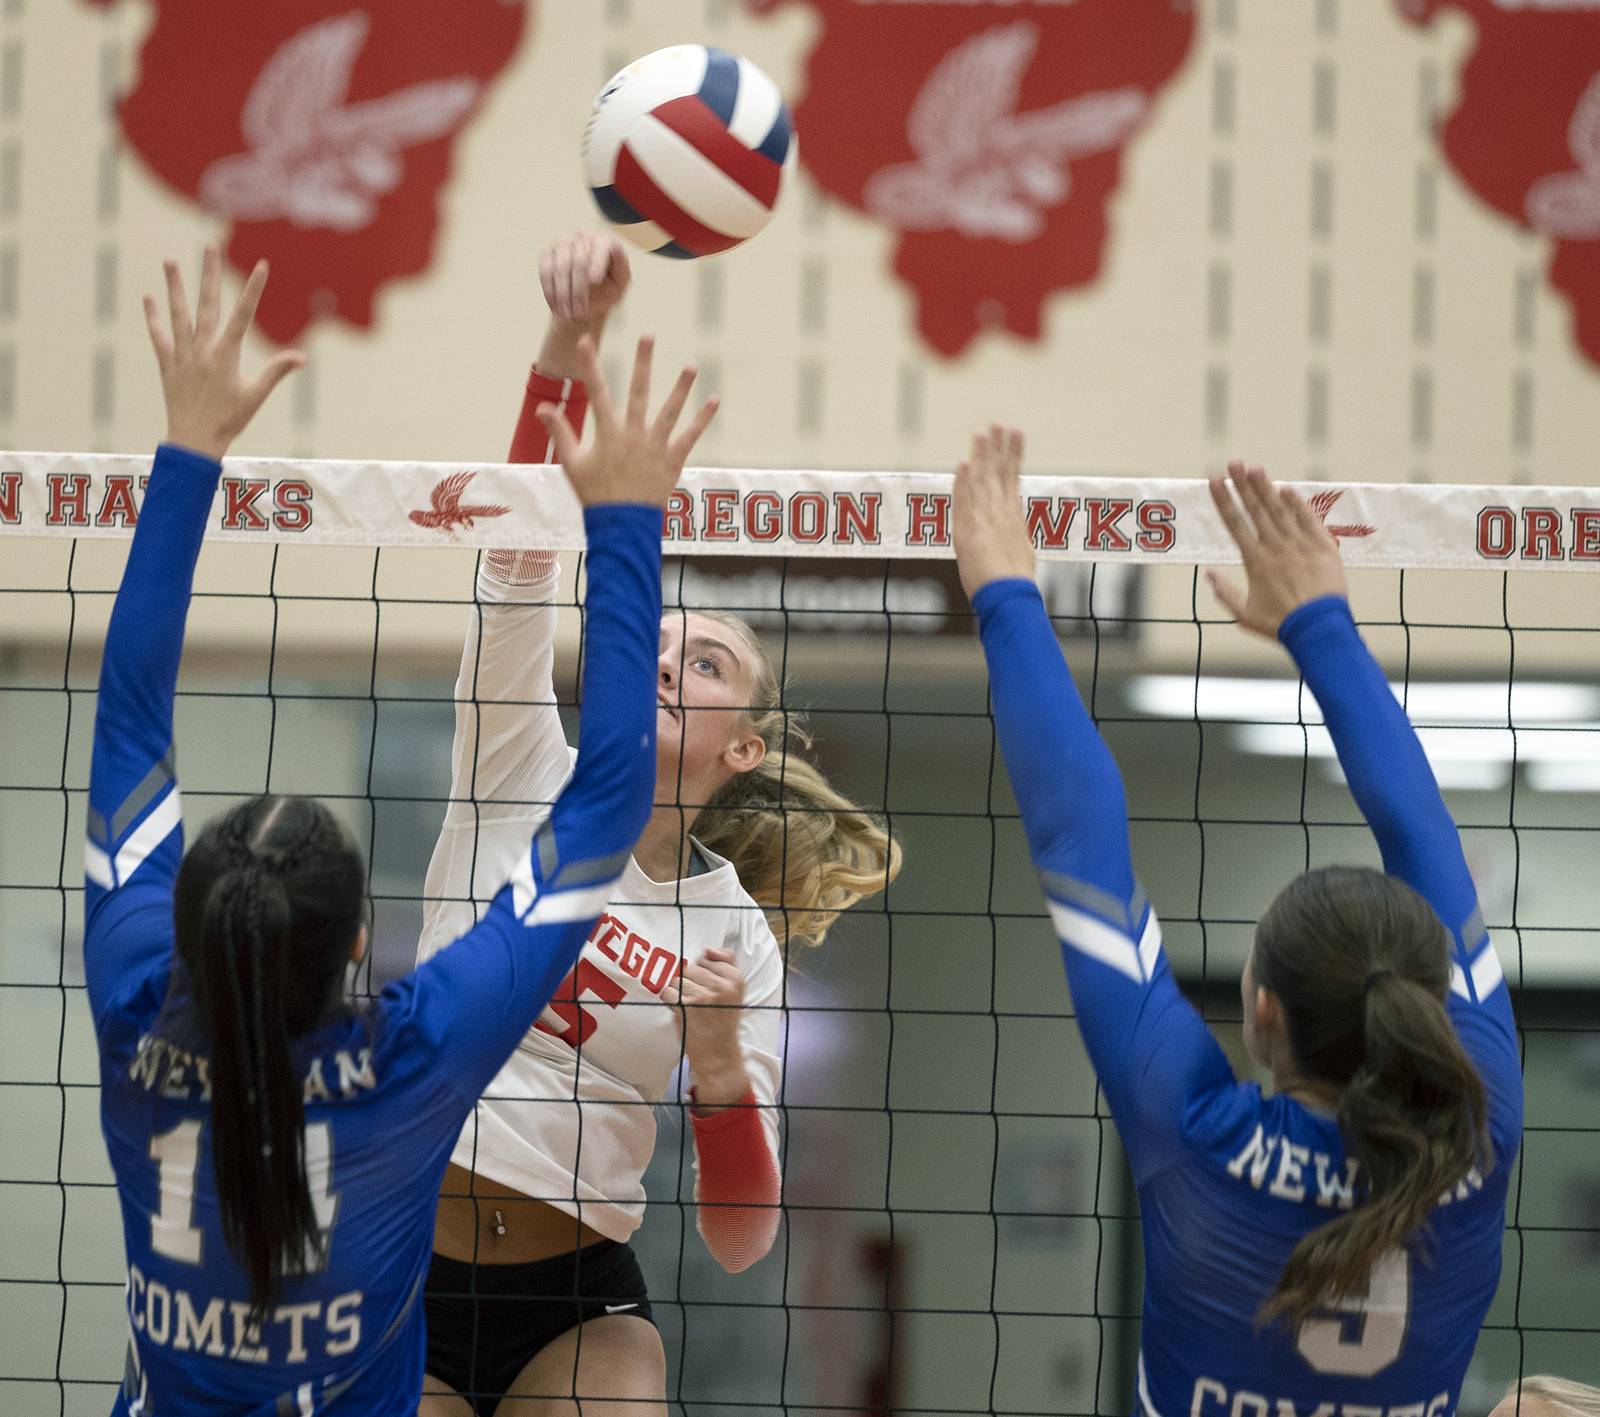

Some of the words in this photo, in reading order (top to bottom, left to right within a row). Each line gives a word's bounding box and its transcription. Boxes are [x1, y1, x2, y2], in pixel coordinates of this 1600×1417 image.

[45, 473, 312, 532] HAKS
[661, 487, 882, 546] REGON
[905, 493, 1176, 552] HWKS
[1476, 506, 1600, 561] ORE
[129, 1034, 377, 1105] NEAN
[128, 1264, 363, 1364] COMETS
